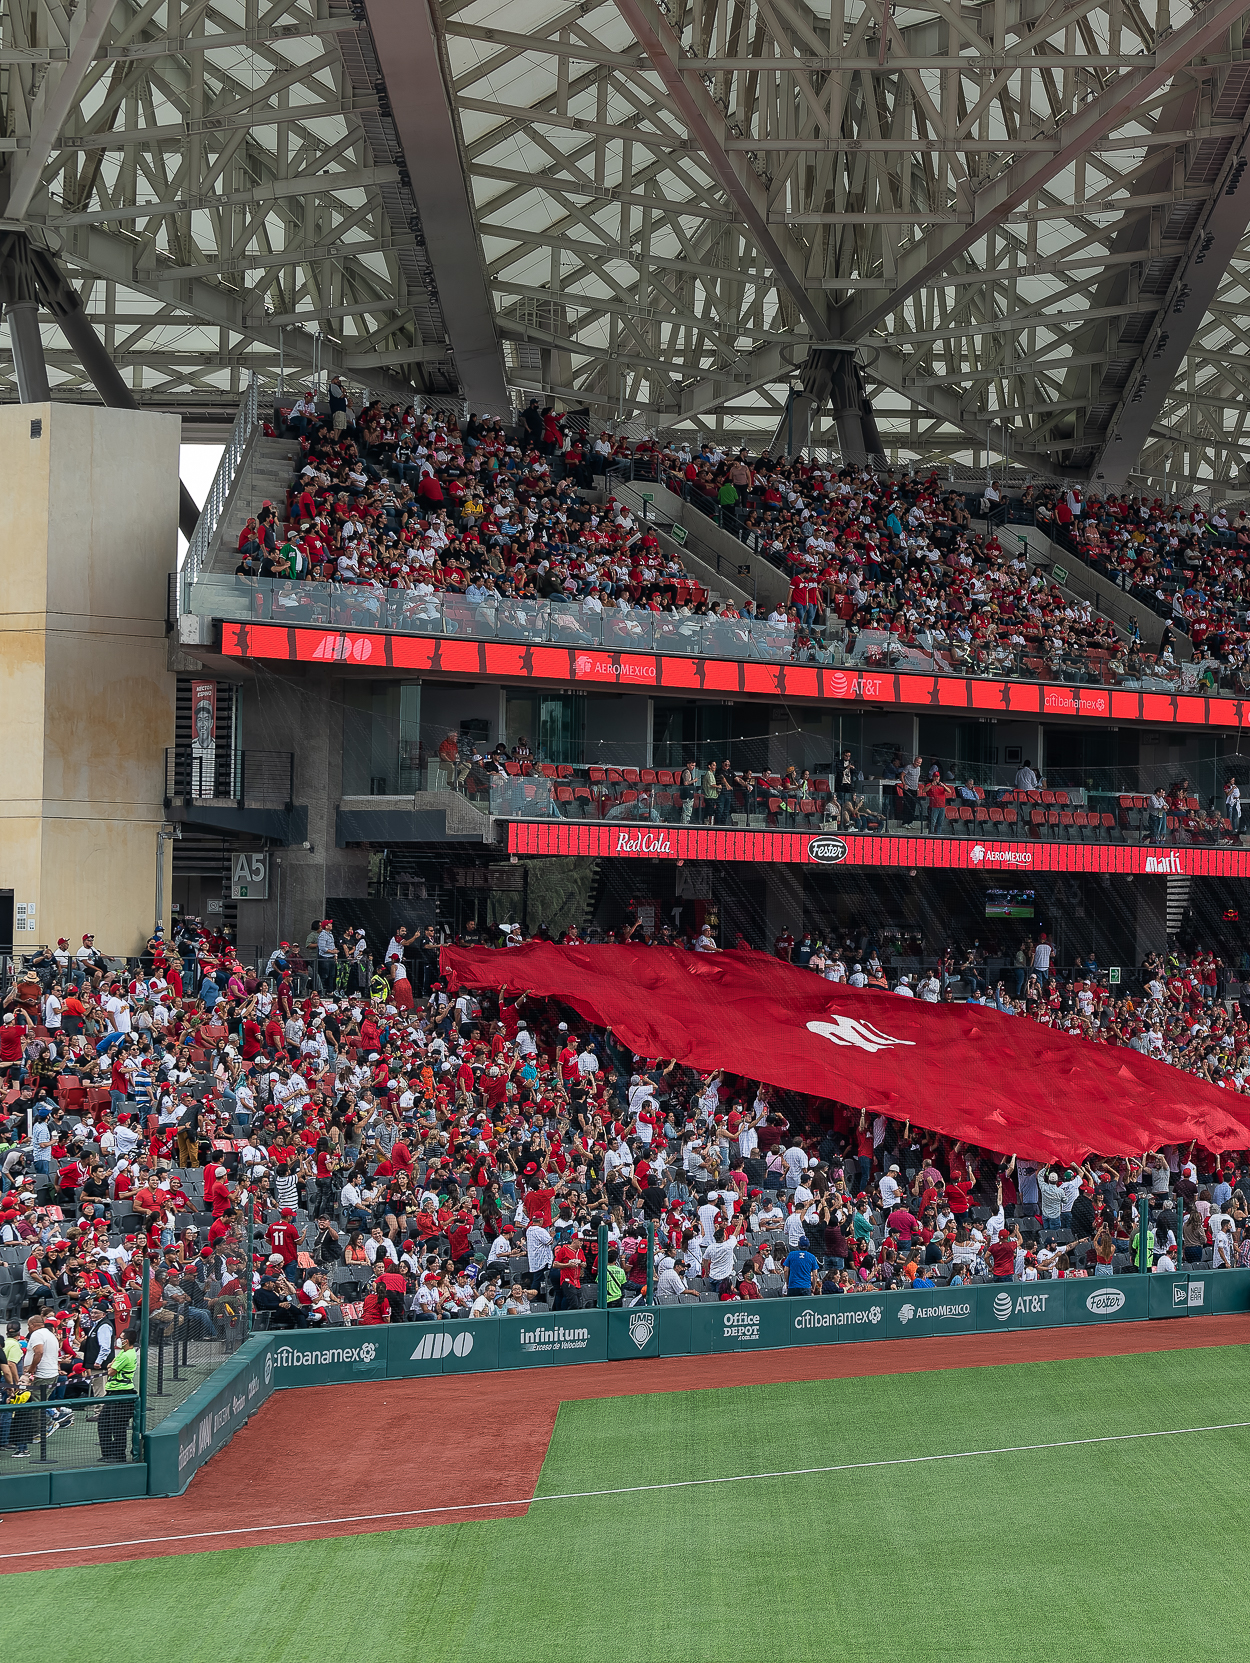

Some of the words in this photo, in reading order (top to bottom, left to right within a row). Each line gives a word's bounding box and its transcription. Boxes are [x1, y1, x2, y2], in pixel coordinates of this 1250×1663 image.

[312, 635, 372, 660] ADO
[850, 678, 882, 696] AT&T
[1045, 693, 1096, 710] citibanamex
[616, 832, 642, 853] Red
[642, 833, 671, 853] Cola
[812, 840, 845, 857] Fester
[233, 854, 265, 882] A5
[273, 1231, 284, 1246] 11
[1015, 1294, 1049, 1314] AT&T
[1090, 1293, 1122, 1310] Fester
[629, 1313, 655, 1328] LMB
[724, 1313, 760, 1326] Office
[795, 1310, 869, 1329] citibanamex
[520, 1327, 588, 1344] infinitum
[723, 1326, 759, 1337] DEPOT
[410, 1332, 473, 1360] ADO
[561, 1340, 588, 1350] Velocidad
